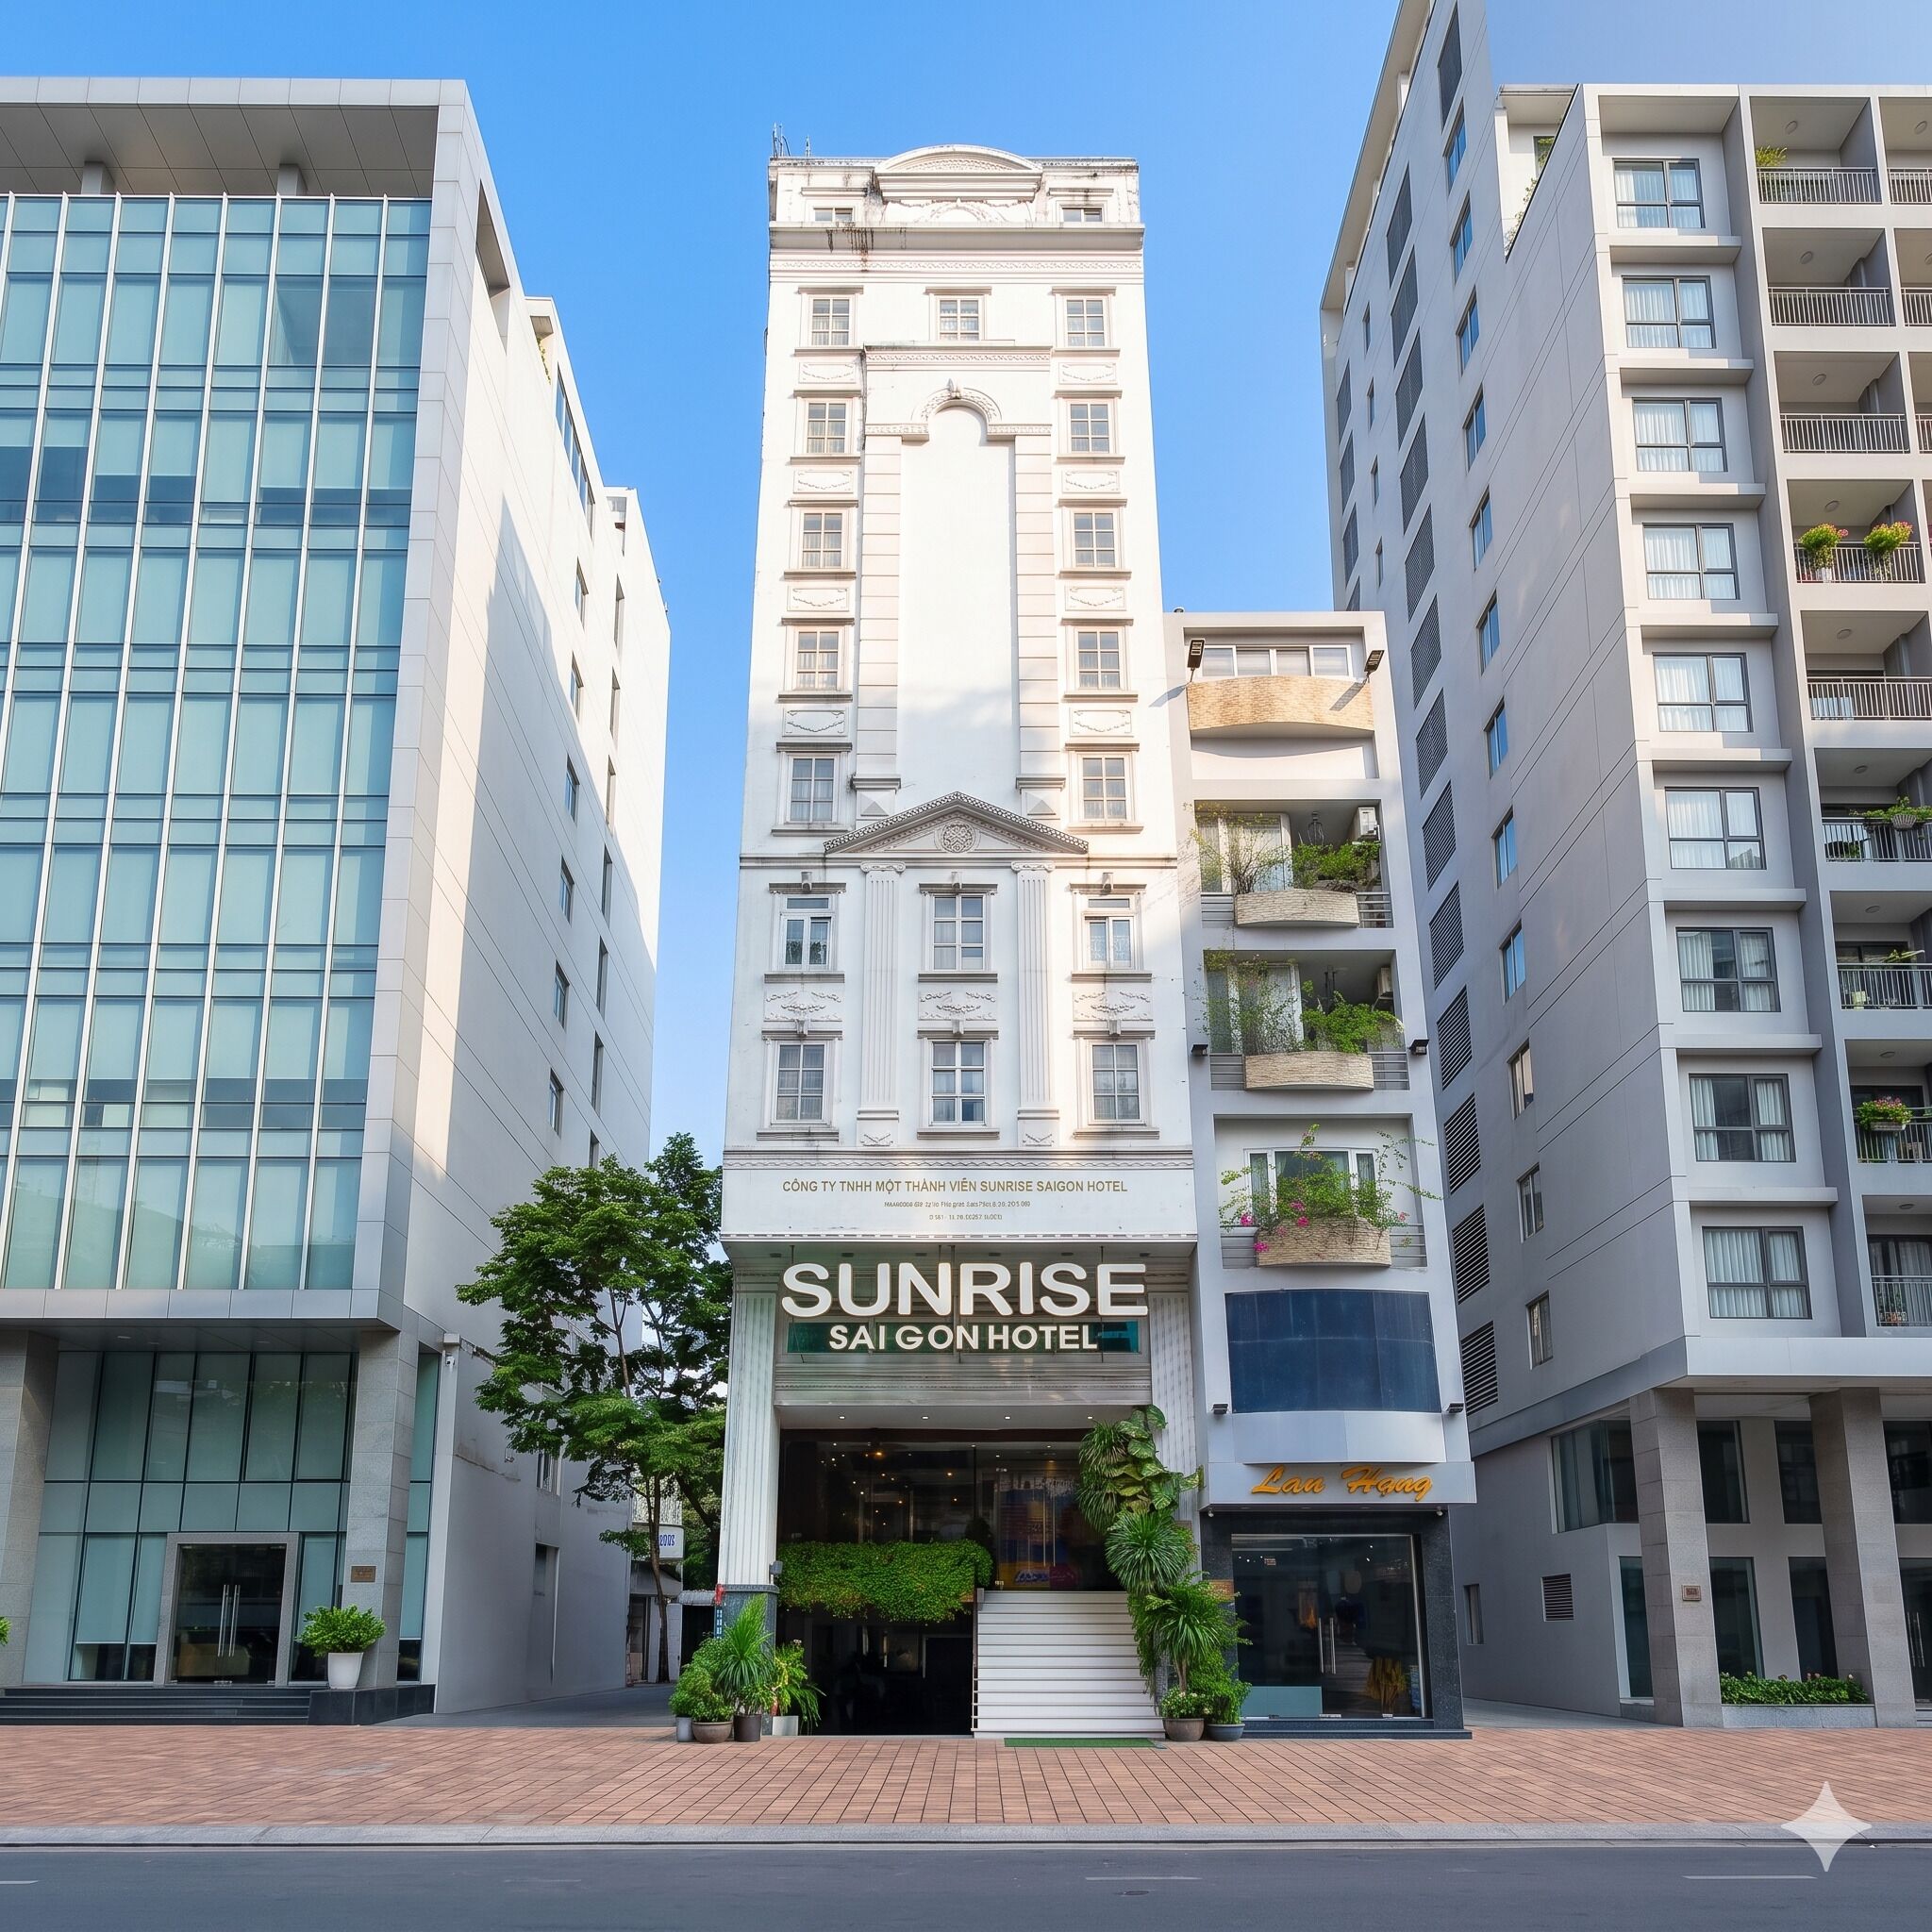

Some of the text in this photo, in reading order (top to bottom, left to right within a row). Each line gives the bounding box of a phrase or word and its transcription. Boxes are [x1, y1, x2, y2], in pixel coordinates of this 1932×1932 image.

[782, 1177, 818, 1192] CÔNG
[821, 1180, 837, 1192] TY
[839, 1180, 873, 1192] TNHH
[979, 1180, 1034, 1192] SUNRISE
[1036, 1180, 1084, 1192] SAIGON
[1087, 1180, 1128, 1192] HOTEL
[781, 1261, 1149, 1318] SUNRISE
[988, 1324, 1097, 1350] HOTEL
[1251, 1465, 1325, 1495] Lan
